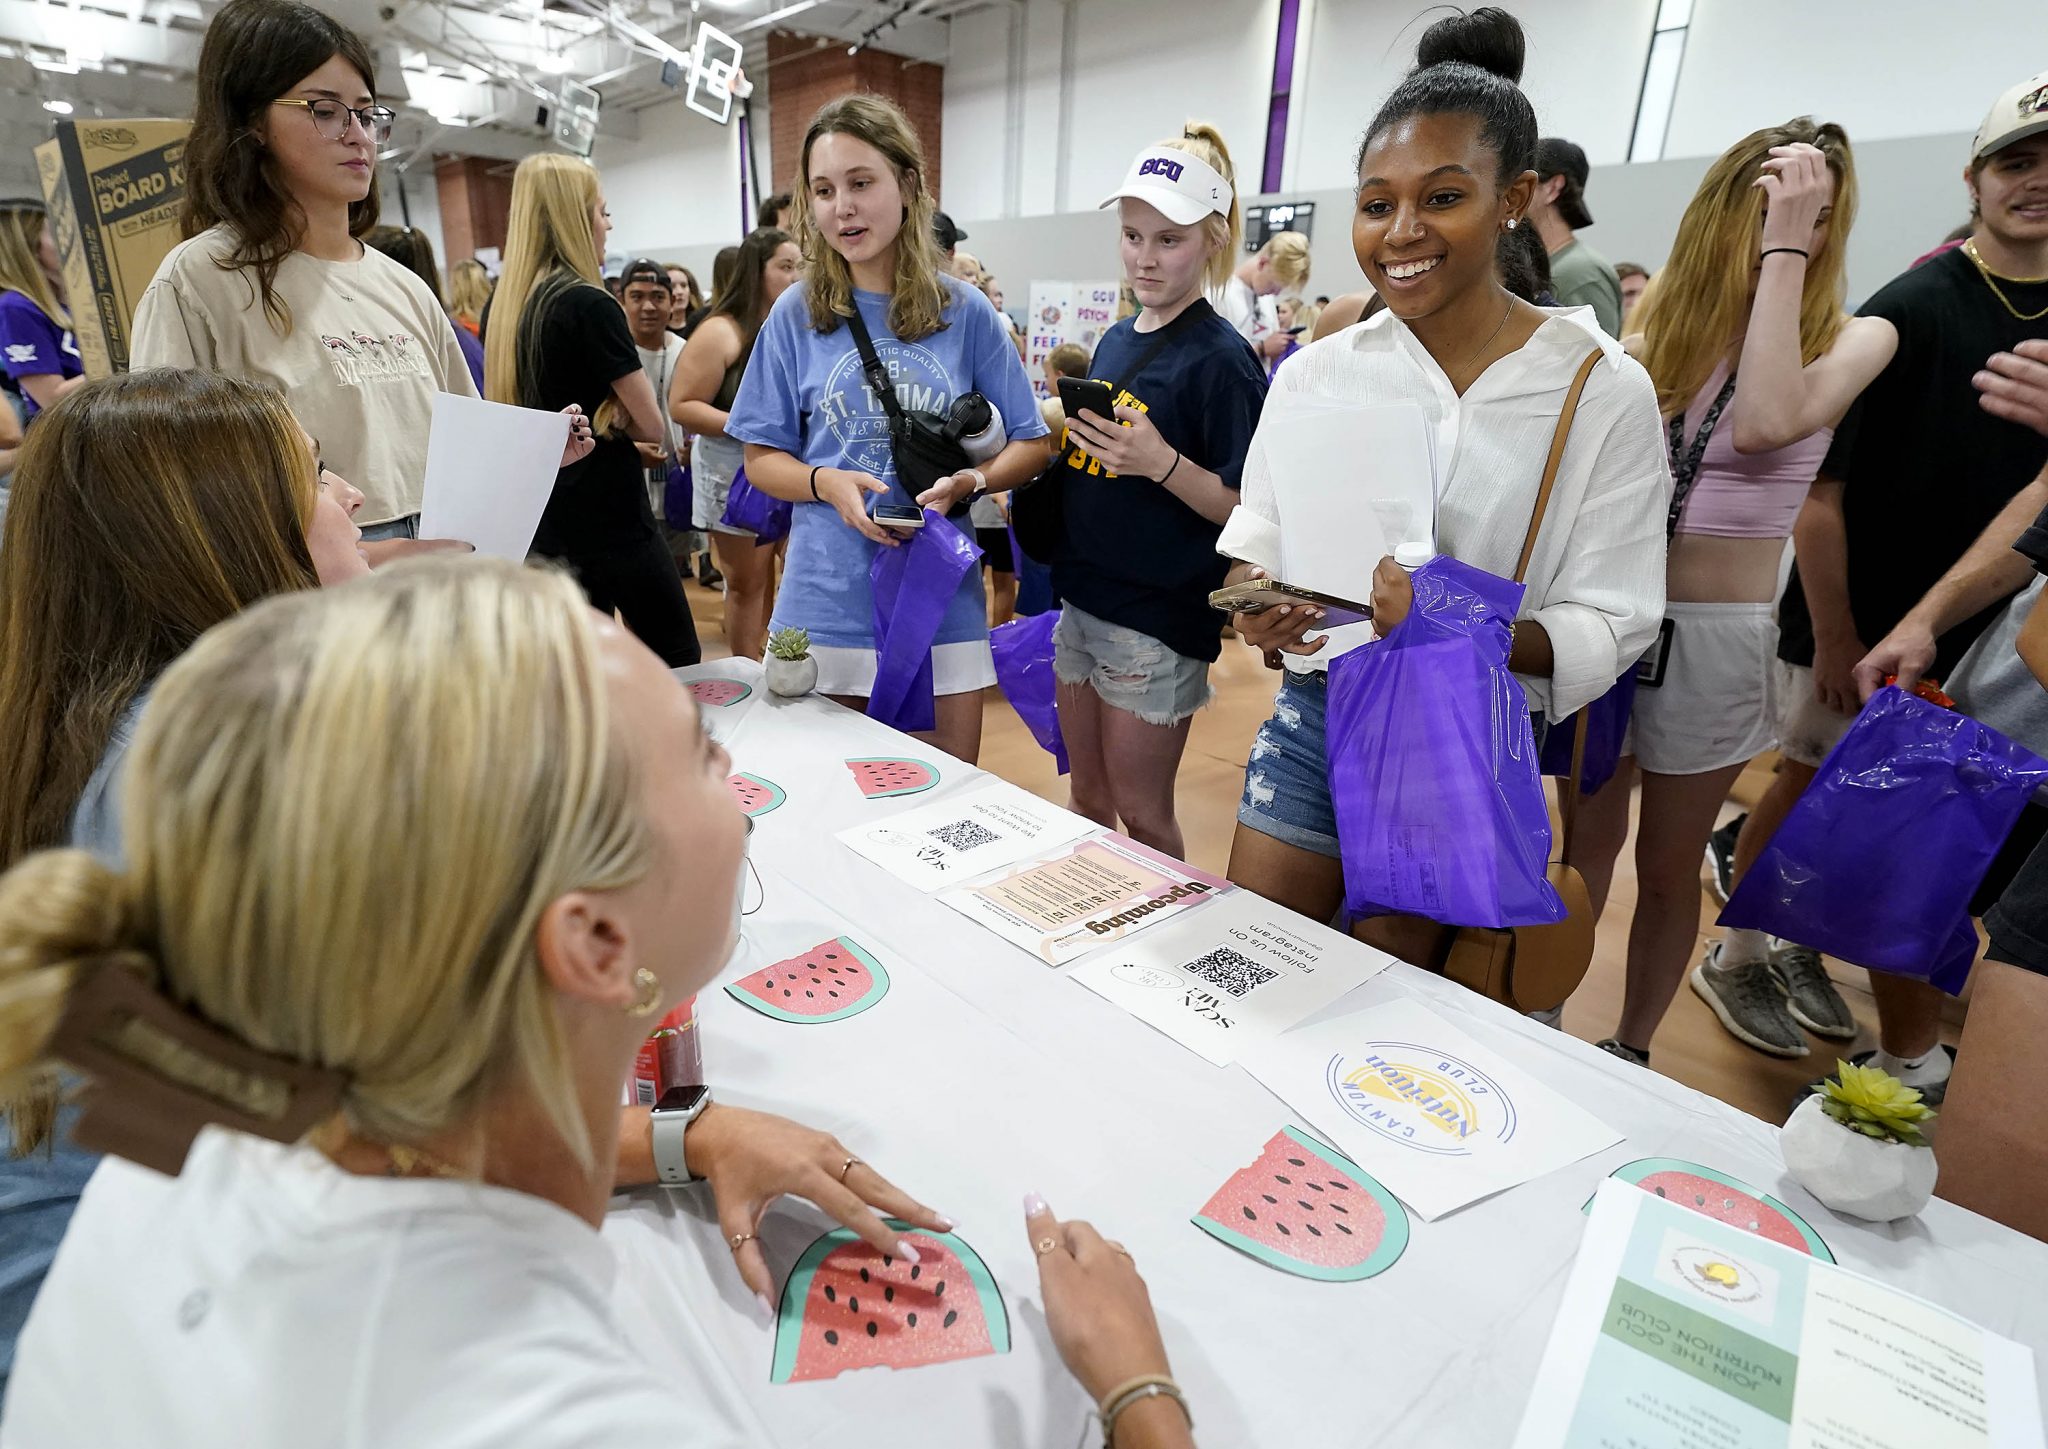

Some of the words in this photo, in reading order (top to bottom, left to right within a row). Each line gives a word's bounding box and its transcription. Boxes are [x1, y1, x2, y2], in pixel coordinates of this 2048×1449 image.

[93, 168, 129, 190] Project
[1139, 158, 1184, 183] GCU
[99, 172, 166, 214] BOARD
[140, 204, 179, 226] HEADE
[1092, 290, 1116, 303] GCU
[902, 350, 943, 380] QUALITY
[819, 390, 858, 426] ST.
[859, 454, 883, 471] Est.
[1085, 881, 1213, 935] Upcoming
[1090, 895, 1107, 904] 10
[1052, 911, 1069, 919] 12
[1229, 927, 1249, 941] On
[1249, 924, 1319, 962] Instagram
[1250, 939, 1268, 951] Us
[1268, 949, 1315, 974] Follow
[1186, 987, 1225, 1008] ME!
[1178, 995, 1235, 1029] SCAN
[1437, 1062, 1488, 1094] CLUB
[1342, 1083, 1415, 1138] CANYON
[1365, 1055, 1480, 1141] Nutrition
[1617, 1316, 1664, 1346] GCU
[1621, 1302, 1671, 1333] CLUB
[1671, 1342, 1705, 1367] THE
[1677, 1328, 1783, 1386] NUTRITION
[1713, 1363, 1762, 1391] JOIN
